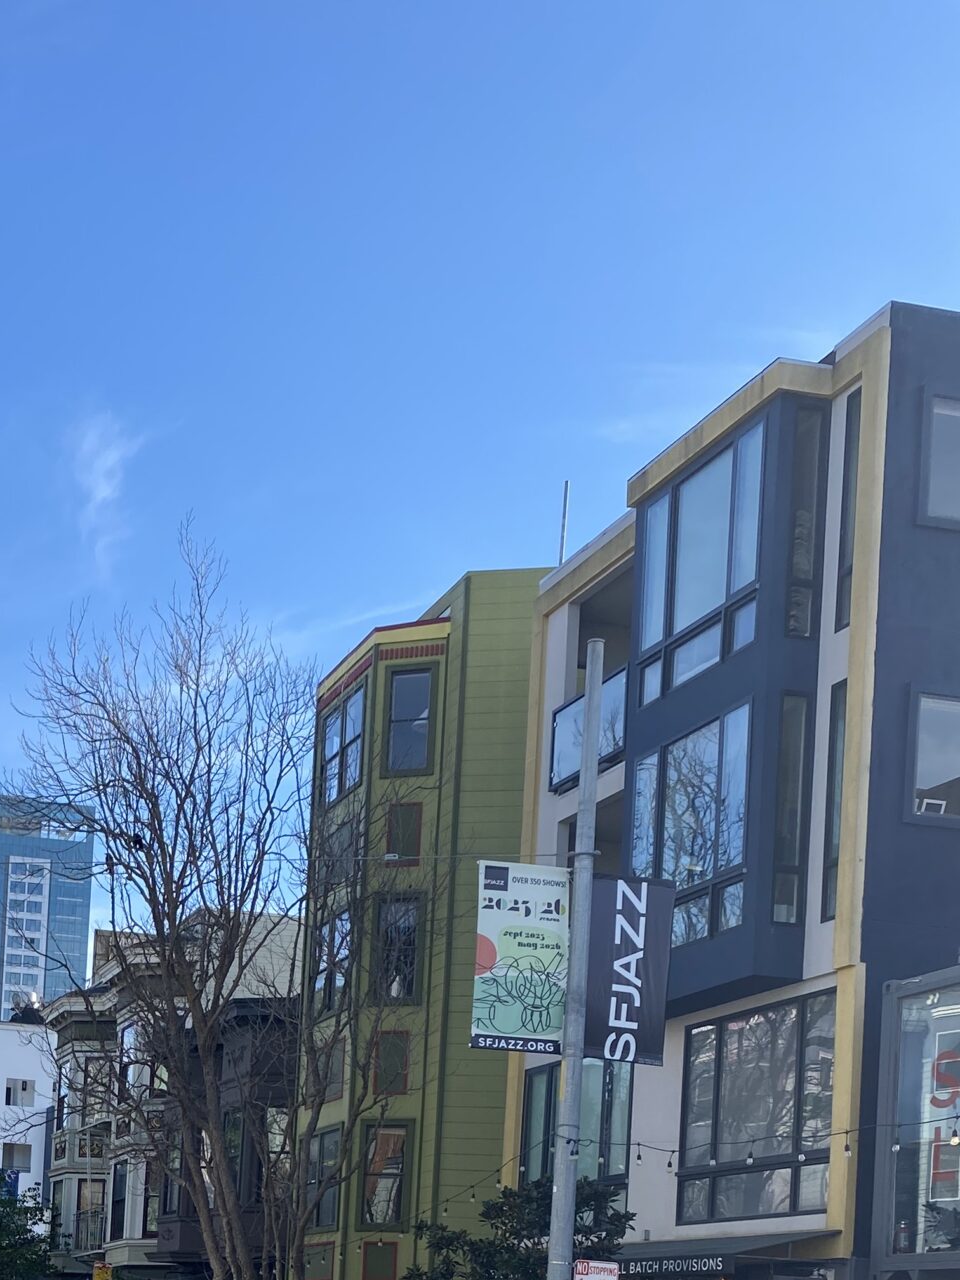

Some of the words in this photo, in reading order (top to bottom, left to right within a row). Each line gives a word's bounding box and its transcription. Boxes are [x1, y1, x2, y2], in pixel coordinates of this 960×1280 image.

[512, 876, 528, 884] OVER
[530, 878, 541, 886] 350
[543, 878, 567, 888] SHOWS!
[604, 880, 648, 1062] SFJAZZ
[478, 1037, 555, 1052] SFJAZZ.ORG
[576, 1261, 589, 1275] NO
[589, 1265, 617, 1277] STOPPING
[629, 1260, 659, 1274] BATCH
[662, 1258, 723, 1272] PROVISIONS
